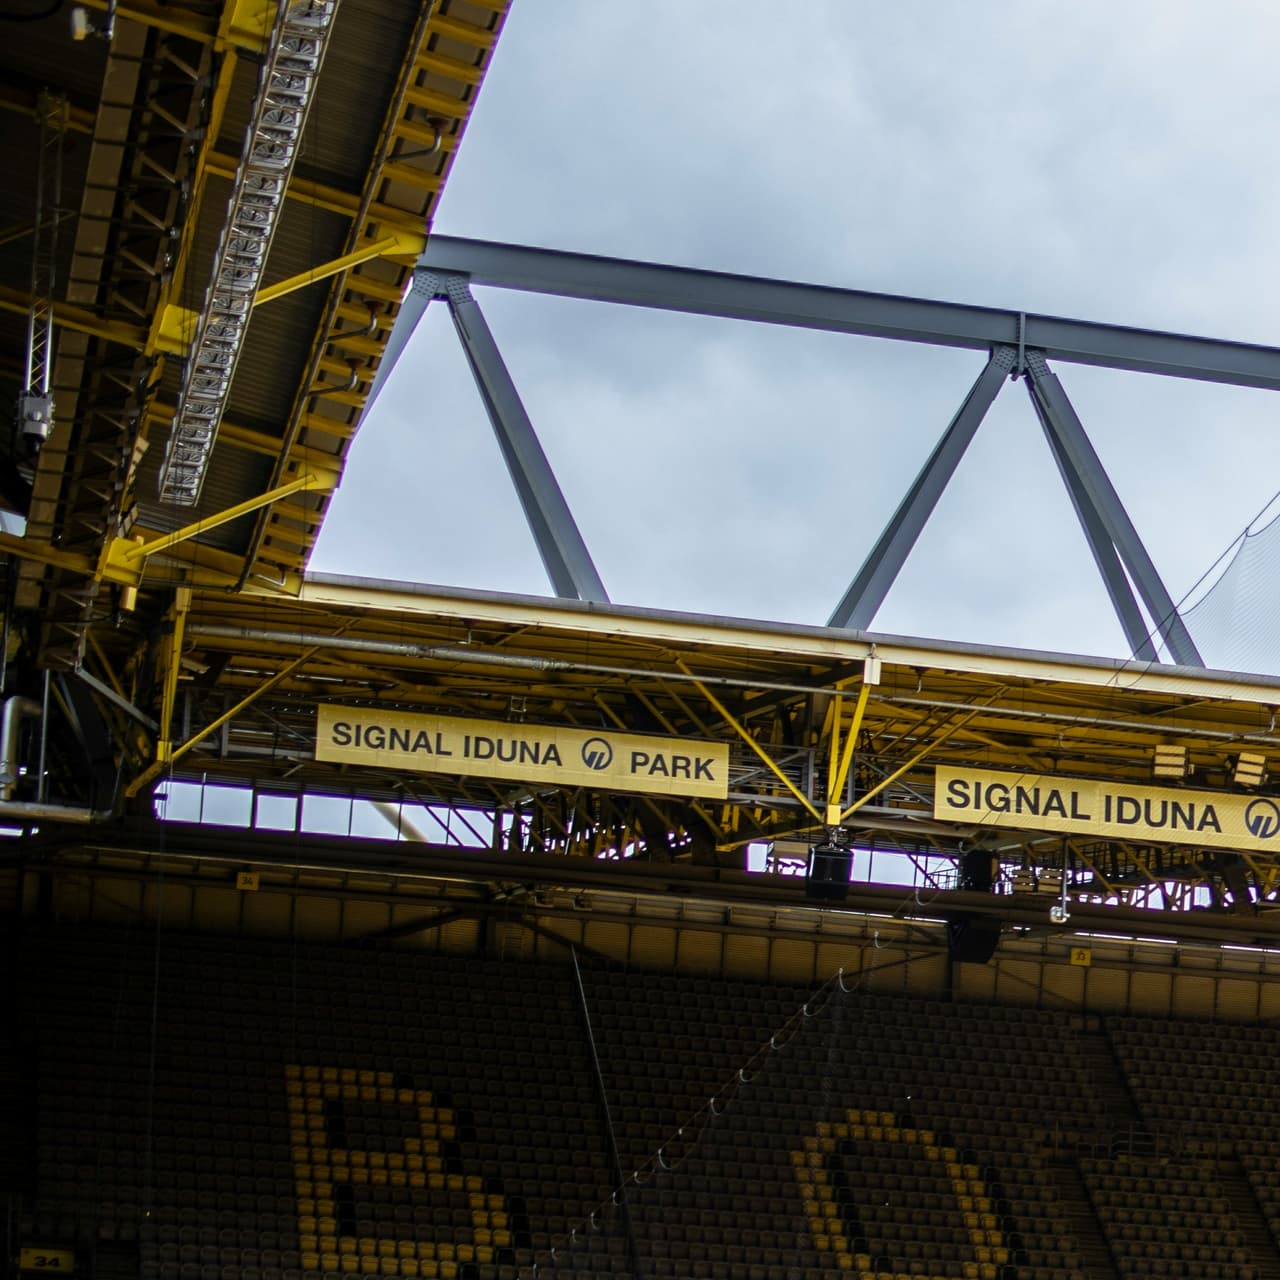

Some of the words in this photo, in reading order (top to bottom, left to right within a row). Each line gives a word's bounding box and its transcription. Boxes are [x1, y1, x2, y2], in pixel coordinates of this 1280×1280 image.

[332, 721, 452, 756] SIGNAL
[463, 735, 563, 767] IDUNA
[630, 751, 715, 781] PARK
[946, 779, 1091, 822] SIGNAL
[1104, 794, 1222, 834] IDUNA
[34, 1256, 59, 1267] 34
